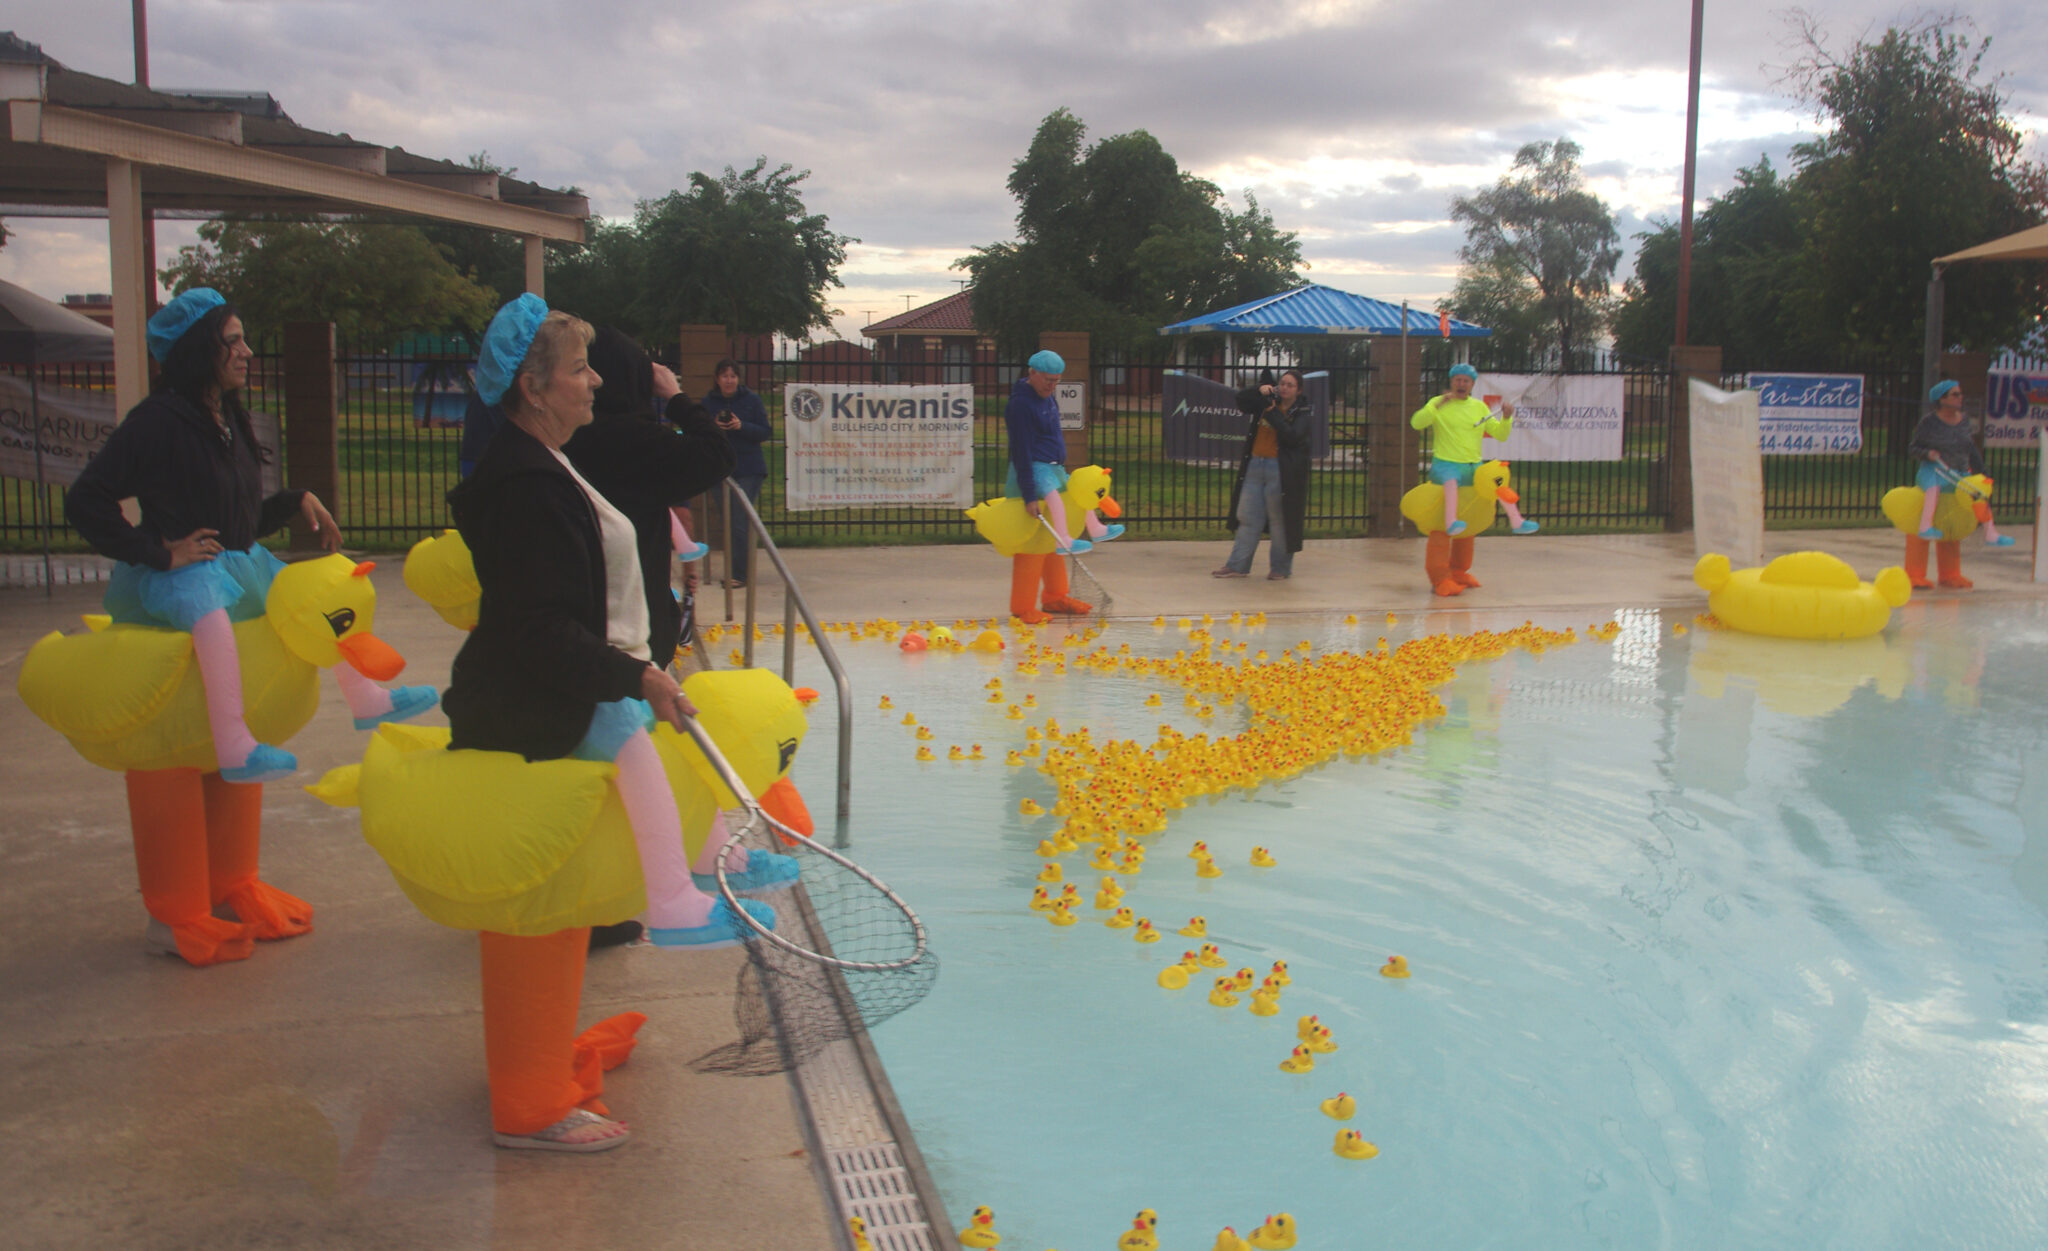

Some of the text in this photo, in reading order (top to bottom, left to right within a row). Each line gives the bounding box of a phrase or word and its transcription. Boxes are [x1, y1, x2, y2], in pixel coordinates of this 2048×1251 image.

[1061, 390, 1077, 398] NO
[1753, 380, 1858, 405] tri-state
[1988, 374, 2031, 419] US
[831, 392, 969, 418] Kiwanis
[1191, 406, 1244, 417] AVANTUS
[1513, 406, 1618, 419] ESTERN ARIZONA
[832, 422, 888, 432] BULLHEAD
[918, 422, 969, 432] MORNING
[1546, 421, 1583, 431] MEDICAL
[1585, 421, 1619, 431] CENTER
[1984, 424, 2025, 439] Sales
[1, 436, 73, 458] CASNOS
